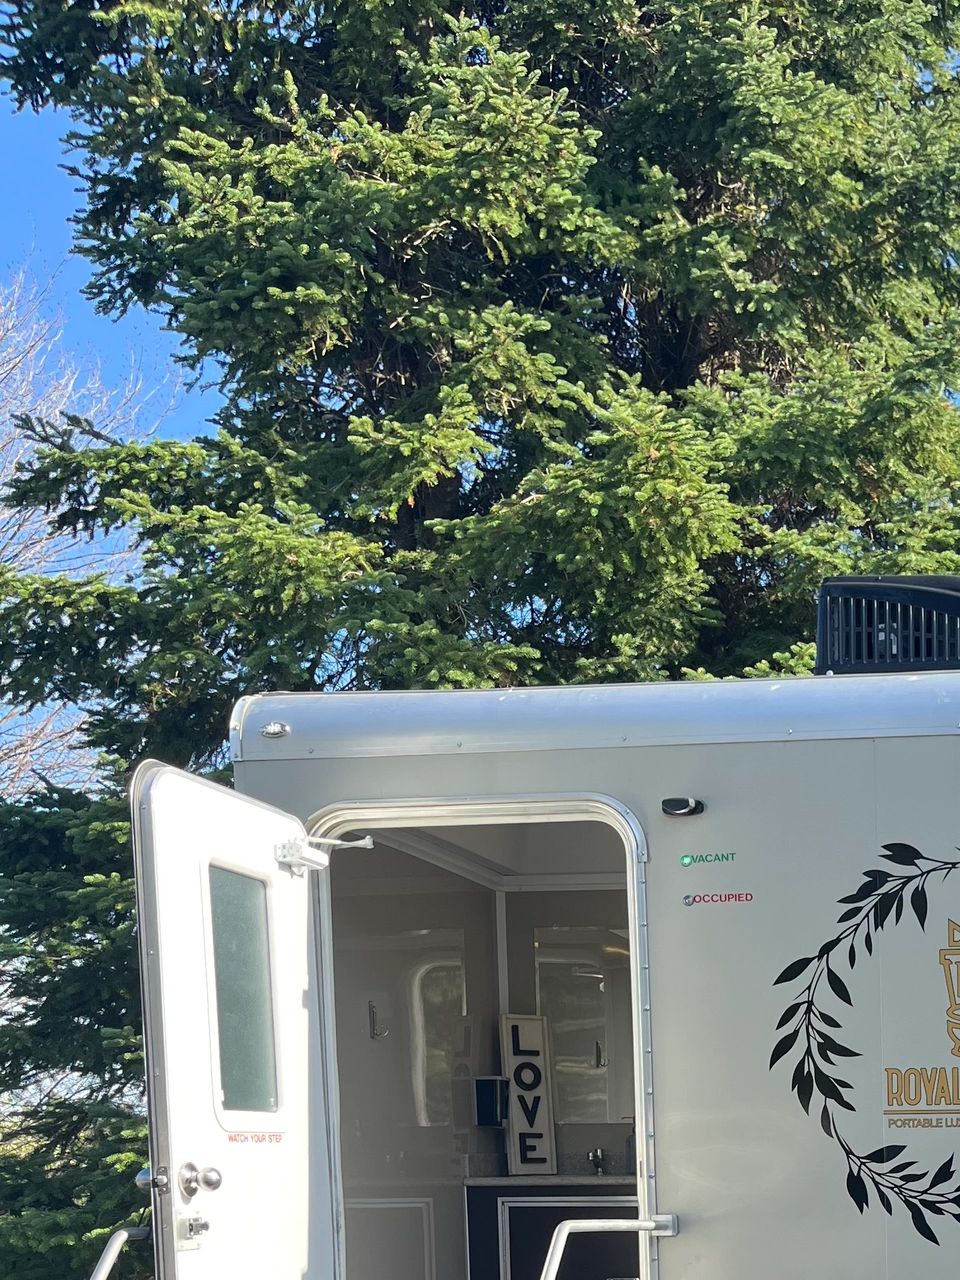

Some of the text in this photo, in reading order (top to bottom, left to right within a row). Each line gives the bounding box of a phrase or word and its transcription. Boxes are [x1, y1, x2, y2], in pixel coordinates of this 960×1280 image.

[691, 853, 737, 863] VACANT
[692, 893, 753, 903] OCCUPIED
[511, 1024, 548, 1165] LOVE
[888, 1118, 944, 1128] PORTABLE
[227, 1133, 283, 1143] WATCH YOUR STEP
